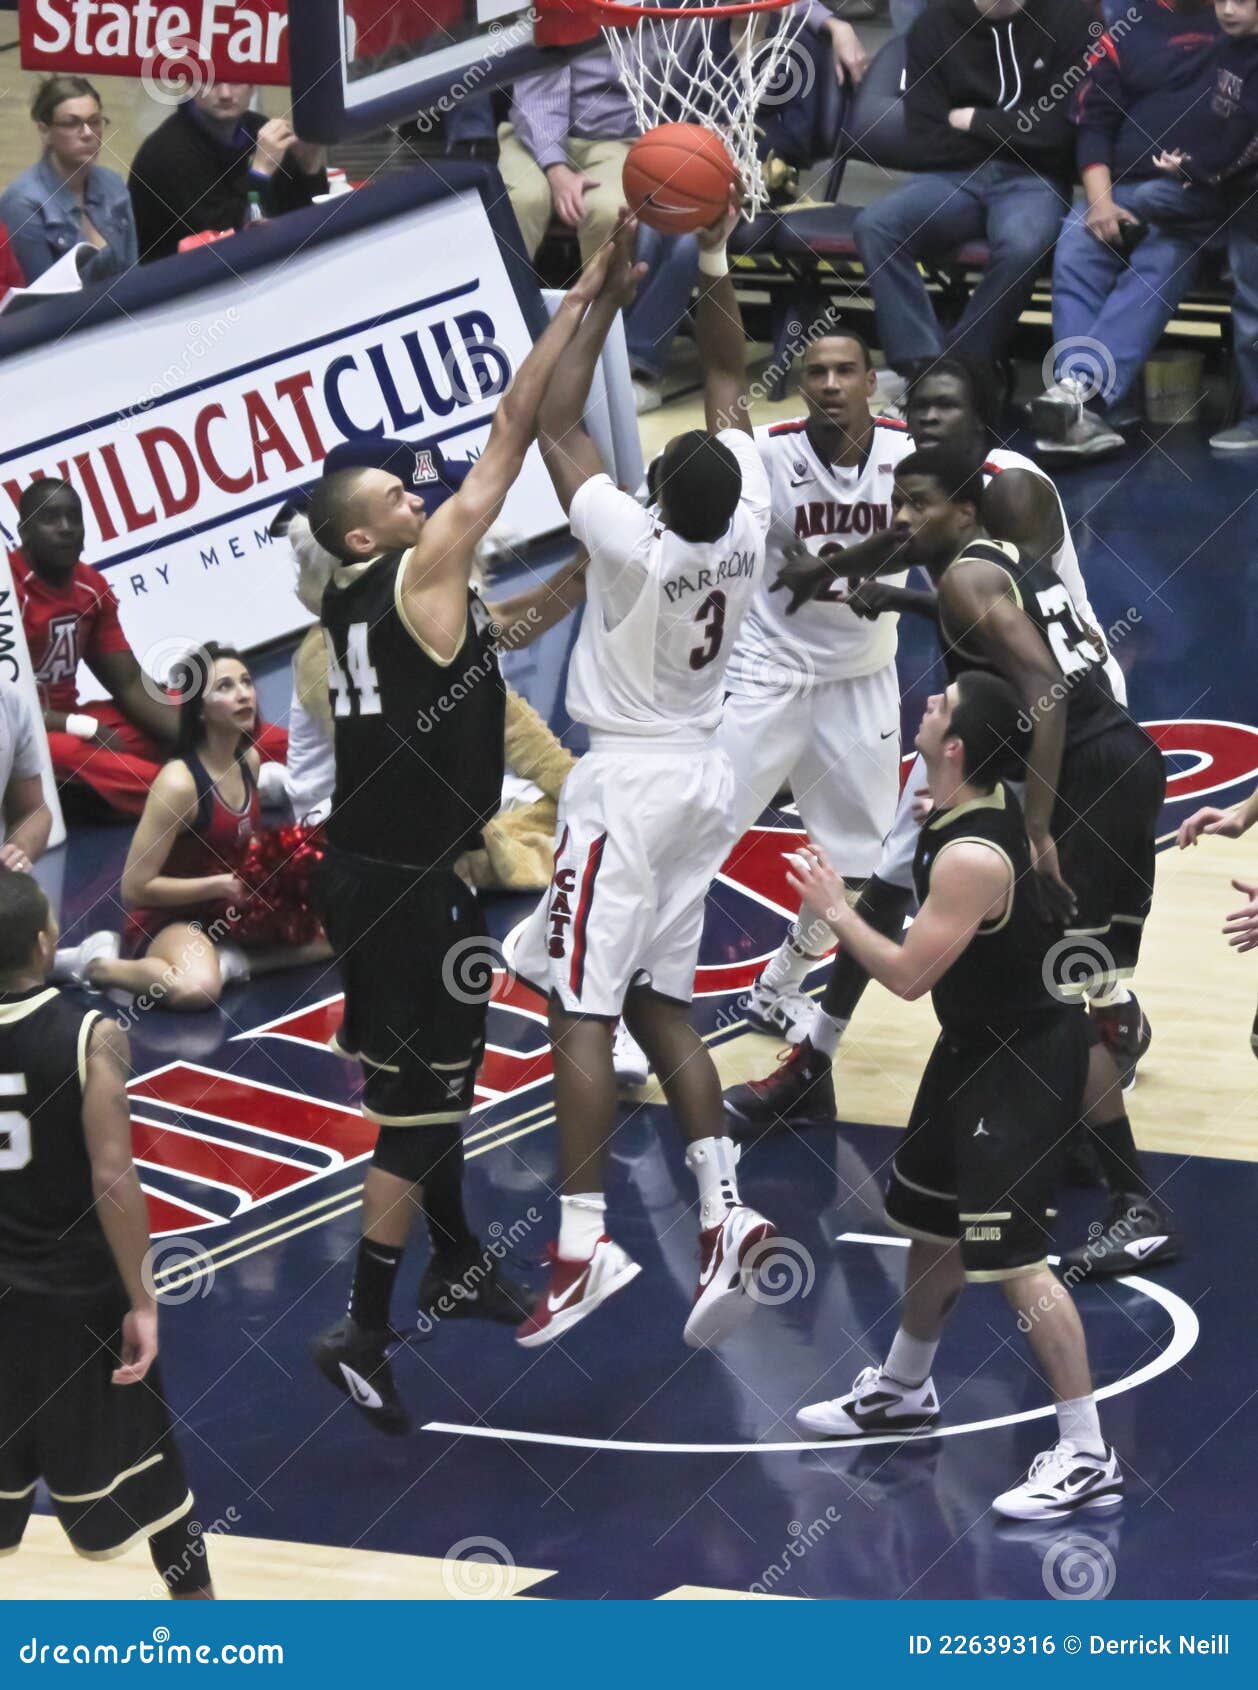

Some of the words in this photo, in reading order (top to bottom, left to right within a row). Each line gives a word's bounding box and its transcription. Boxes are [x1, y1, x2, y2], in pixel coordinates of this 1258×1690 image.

[793, 501, 896, 540] ARIZON
[663, 551, 755, 603] PARROM
[689, 589, 726, 671] 3
[548, 868, 577, 959] CATS
